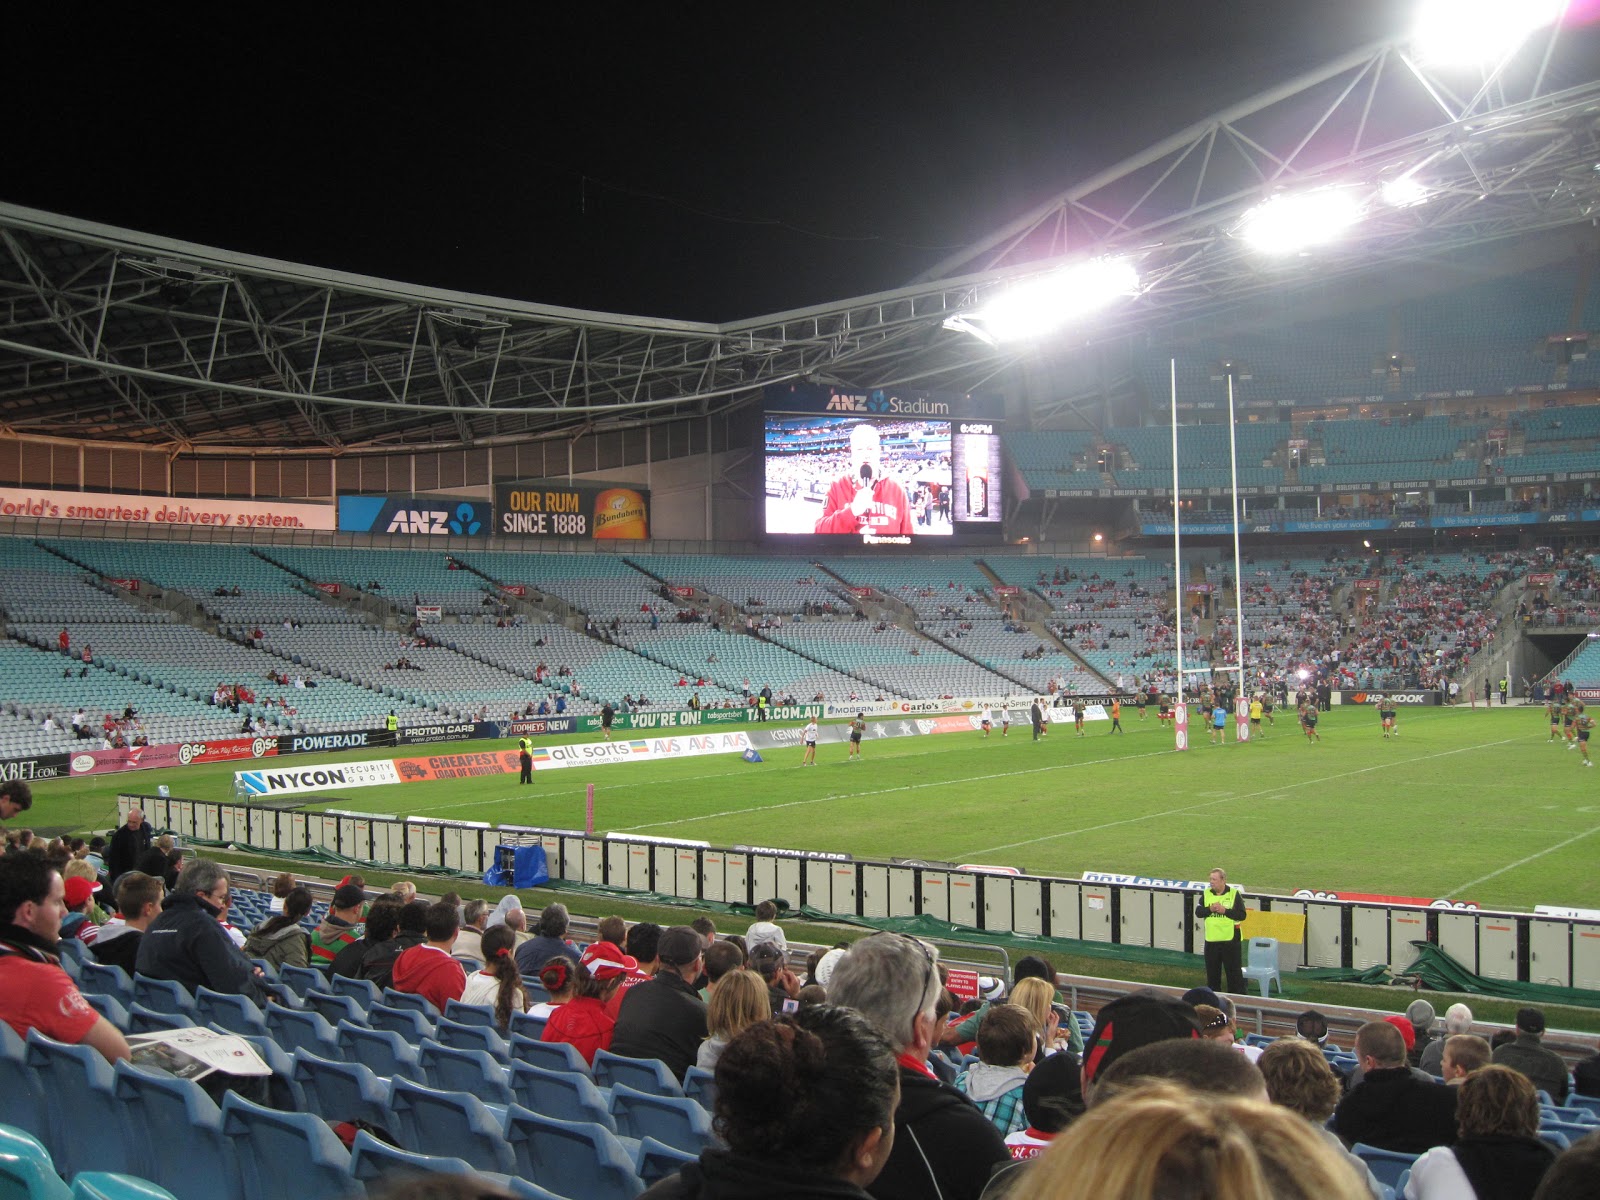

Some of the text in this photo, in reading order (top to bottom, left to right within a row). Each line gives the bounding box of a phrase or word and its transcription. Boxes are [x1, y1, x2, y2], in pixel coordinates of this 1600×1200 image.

[826, 394, 949, 415] ANZ Stadium
[510, 491, 579, 513] OUR RUM
[66, 504, 149, 521] smartest
[155, 505, 230, 527] delivery
[237, 512, 304, 528] system.
[386, 510, 449, 534] ANZ
[503, 513, 586, 535] SINCE 1888
[596, 509, 643, 526] Bundaberg
[863, 534, 912, 545] Panasonic
[835, 705, 873, 714] MODERN
[901, 702, 938, 713] Garlo's
[512, 720, 570, 733] TOOHEYS NEW
[630, 712, 677, 728] YOU'RE
[680, 711, 702, 724] ON!
[708, 711, 742, 719] tabsportsbet
[405, 724, 475, 737] PROTON CARS
[410, 733, 470, 744] www.proton.com.au
[293, 732, 369, 751] POWERADE
[654, 733, 748, 754] AVS AVS AVS
[552, 741, 630, 760] all sorts
[344, 763, 391, 775] SECURITY
[428, 753, 499, 769] CHEAPEST
[566, 756, 624, 768] fitness.com.au
[267, 769, 346, 790] NYCON
[348, 773, 395, 784] GROUP
[434, 765, 505, 779] LOAD OF RUBBISH
